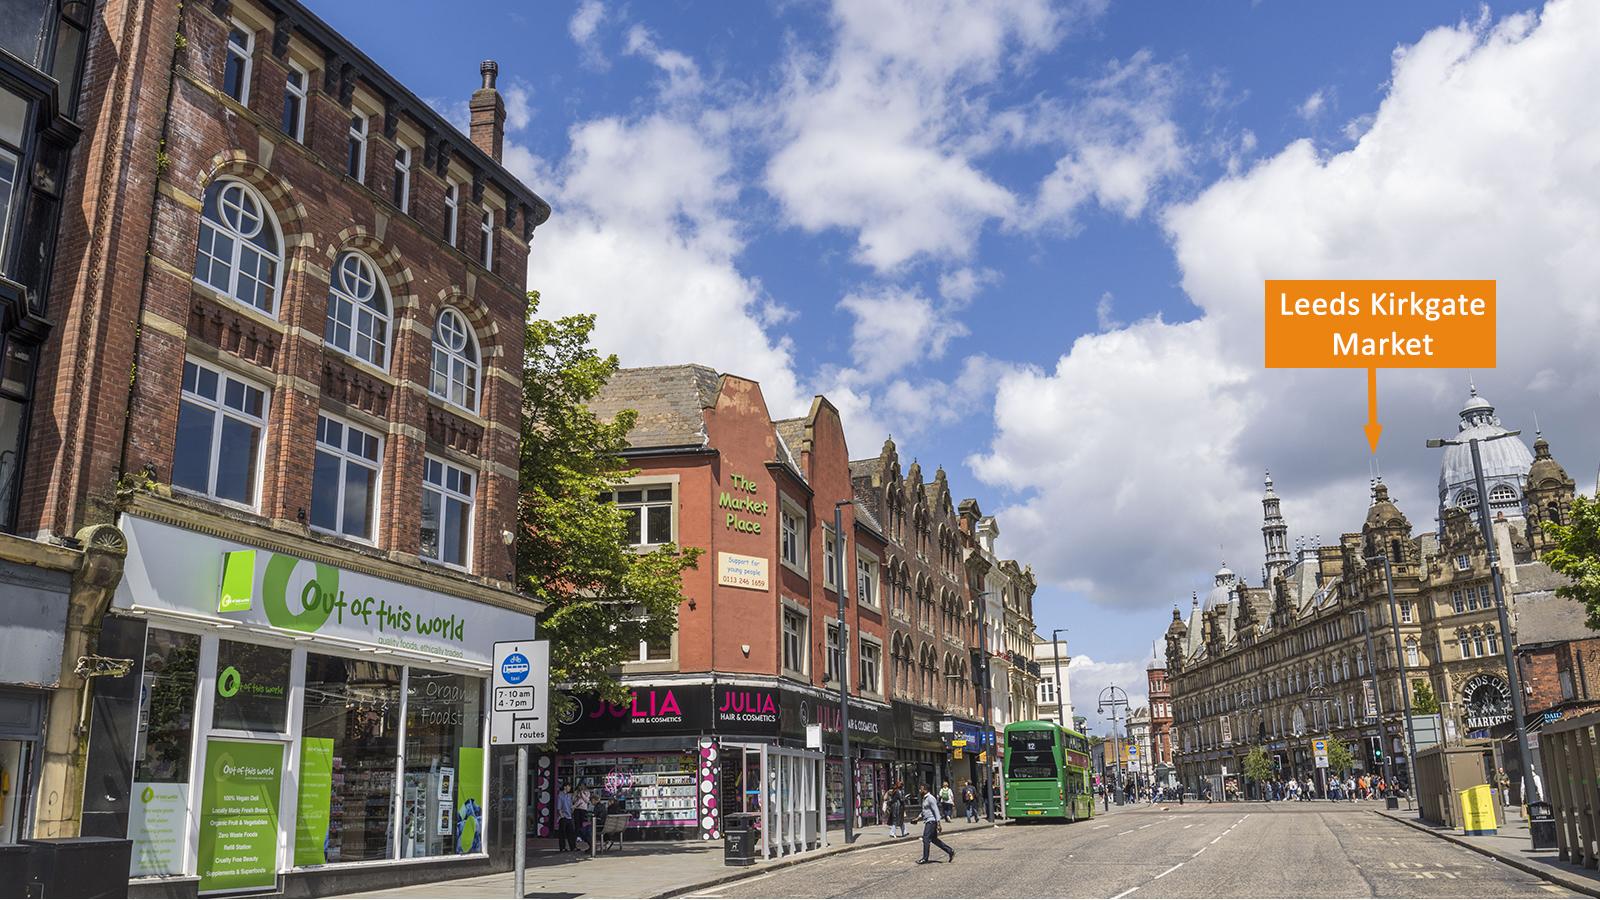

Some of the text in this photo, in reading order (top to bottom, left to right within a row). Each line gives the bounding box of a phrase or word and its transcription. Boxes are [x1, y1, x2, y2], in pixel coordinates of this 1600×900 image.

[731, 473, 757, 492] The
[719, 492, 768, 515] Market
[726, 512, 761, 535] Place
[728, 557, 760, 567] Support for
[727, 566, 761, 577] young people
[723, 575, 766, 587] 0113 246 1659
[302, 579, 465, 642] Out of this world
[378, 636, 399, 648] quality
[420, 644, 444, 656] ethically
[444, 647, 464, 659] traded
[265, 685, 284, 695] world
[1463, 675, 1512, 702] LEEDS CITY
[515, 700, 527, 708] pm
[719, 691, 776, 714] JULIA
[720, 713, 776, 722] HAIR & COSMETICS
[1467, 714, 1513, 728] MARKETS
[520, 722, 531, 730] All
[1027, 742, 1036, 750] 12
[223, 764, 275, 776] Out of this world
[210, 819, 228, 827] Organic
[243, 819, 268, 827] Vegetables
[206, 869, 236, 878] Supplements
